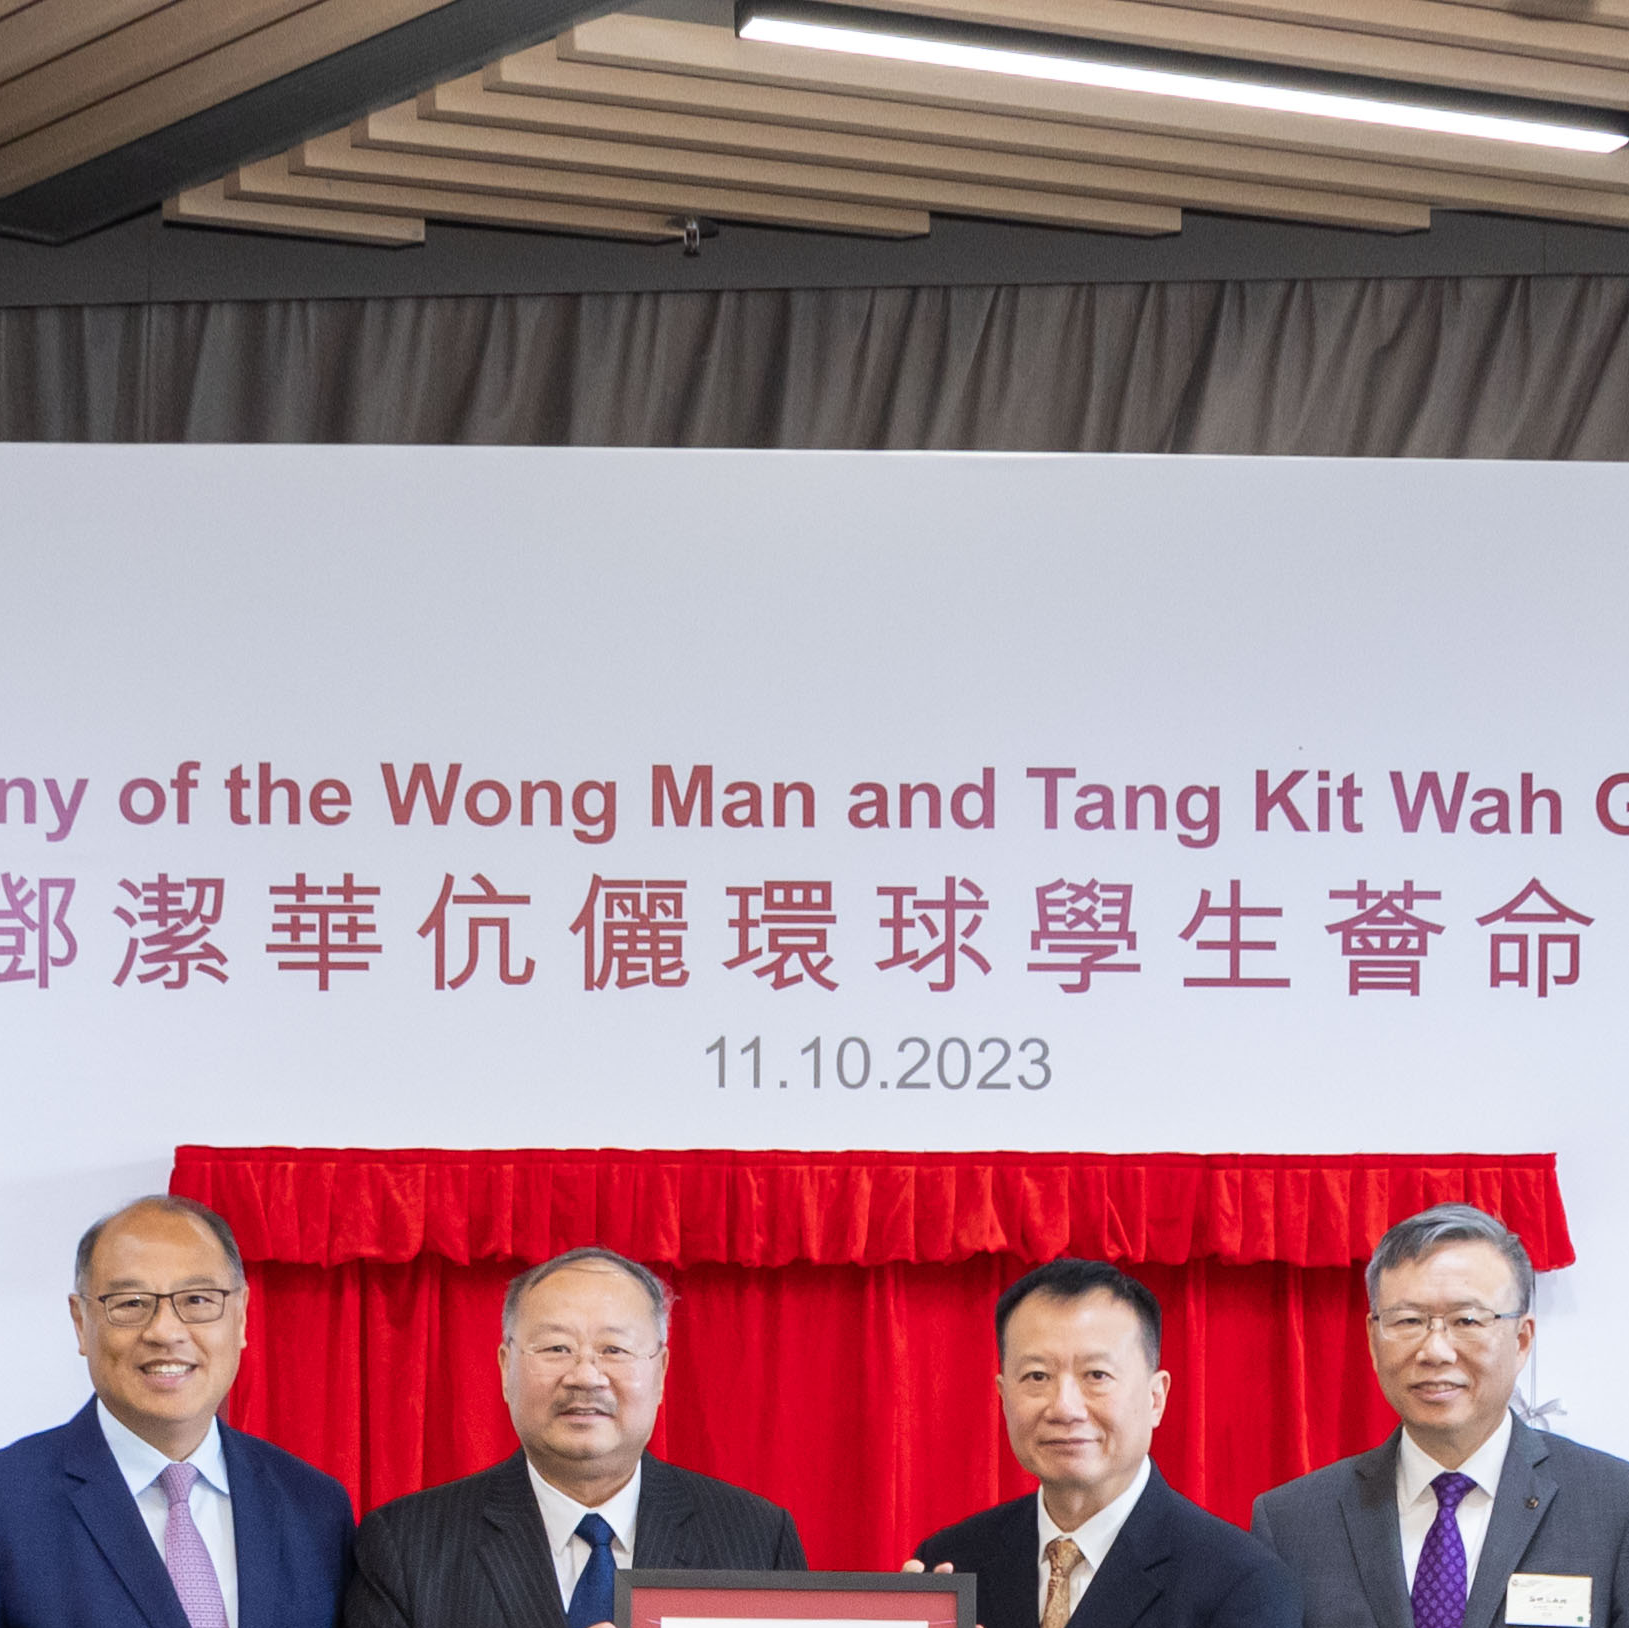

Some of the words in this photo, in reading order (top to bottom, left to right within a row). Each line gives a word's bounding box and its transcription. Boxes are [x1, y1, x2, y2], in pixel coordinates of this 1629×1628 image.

[119, 761, 203, 827] of
[224, 761, 354, 828] the
[380, 762, 619, 846] Wong
[652, 764, 817, 830] Man
[848, 767, 997, 832] and
[1026, 767, 1222, 850] Tang
[1255, 769, 1365, 835] Kit
[1389, 770, 1564, 837] Wah
[706, 1035, 1053, 1091] 11.10.2023
